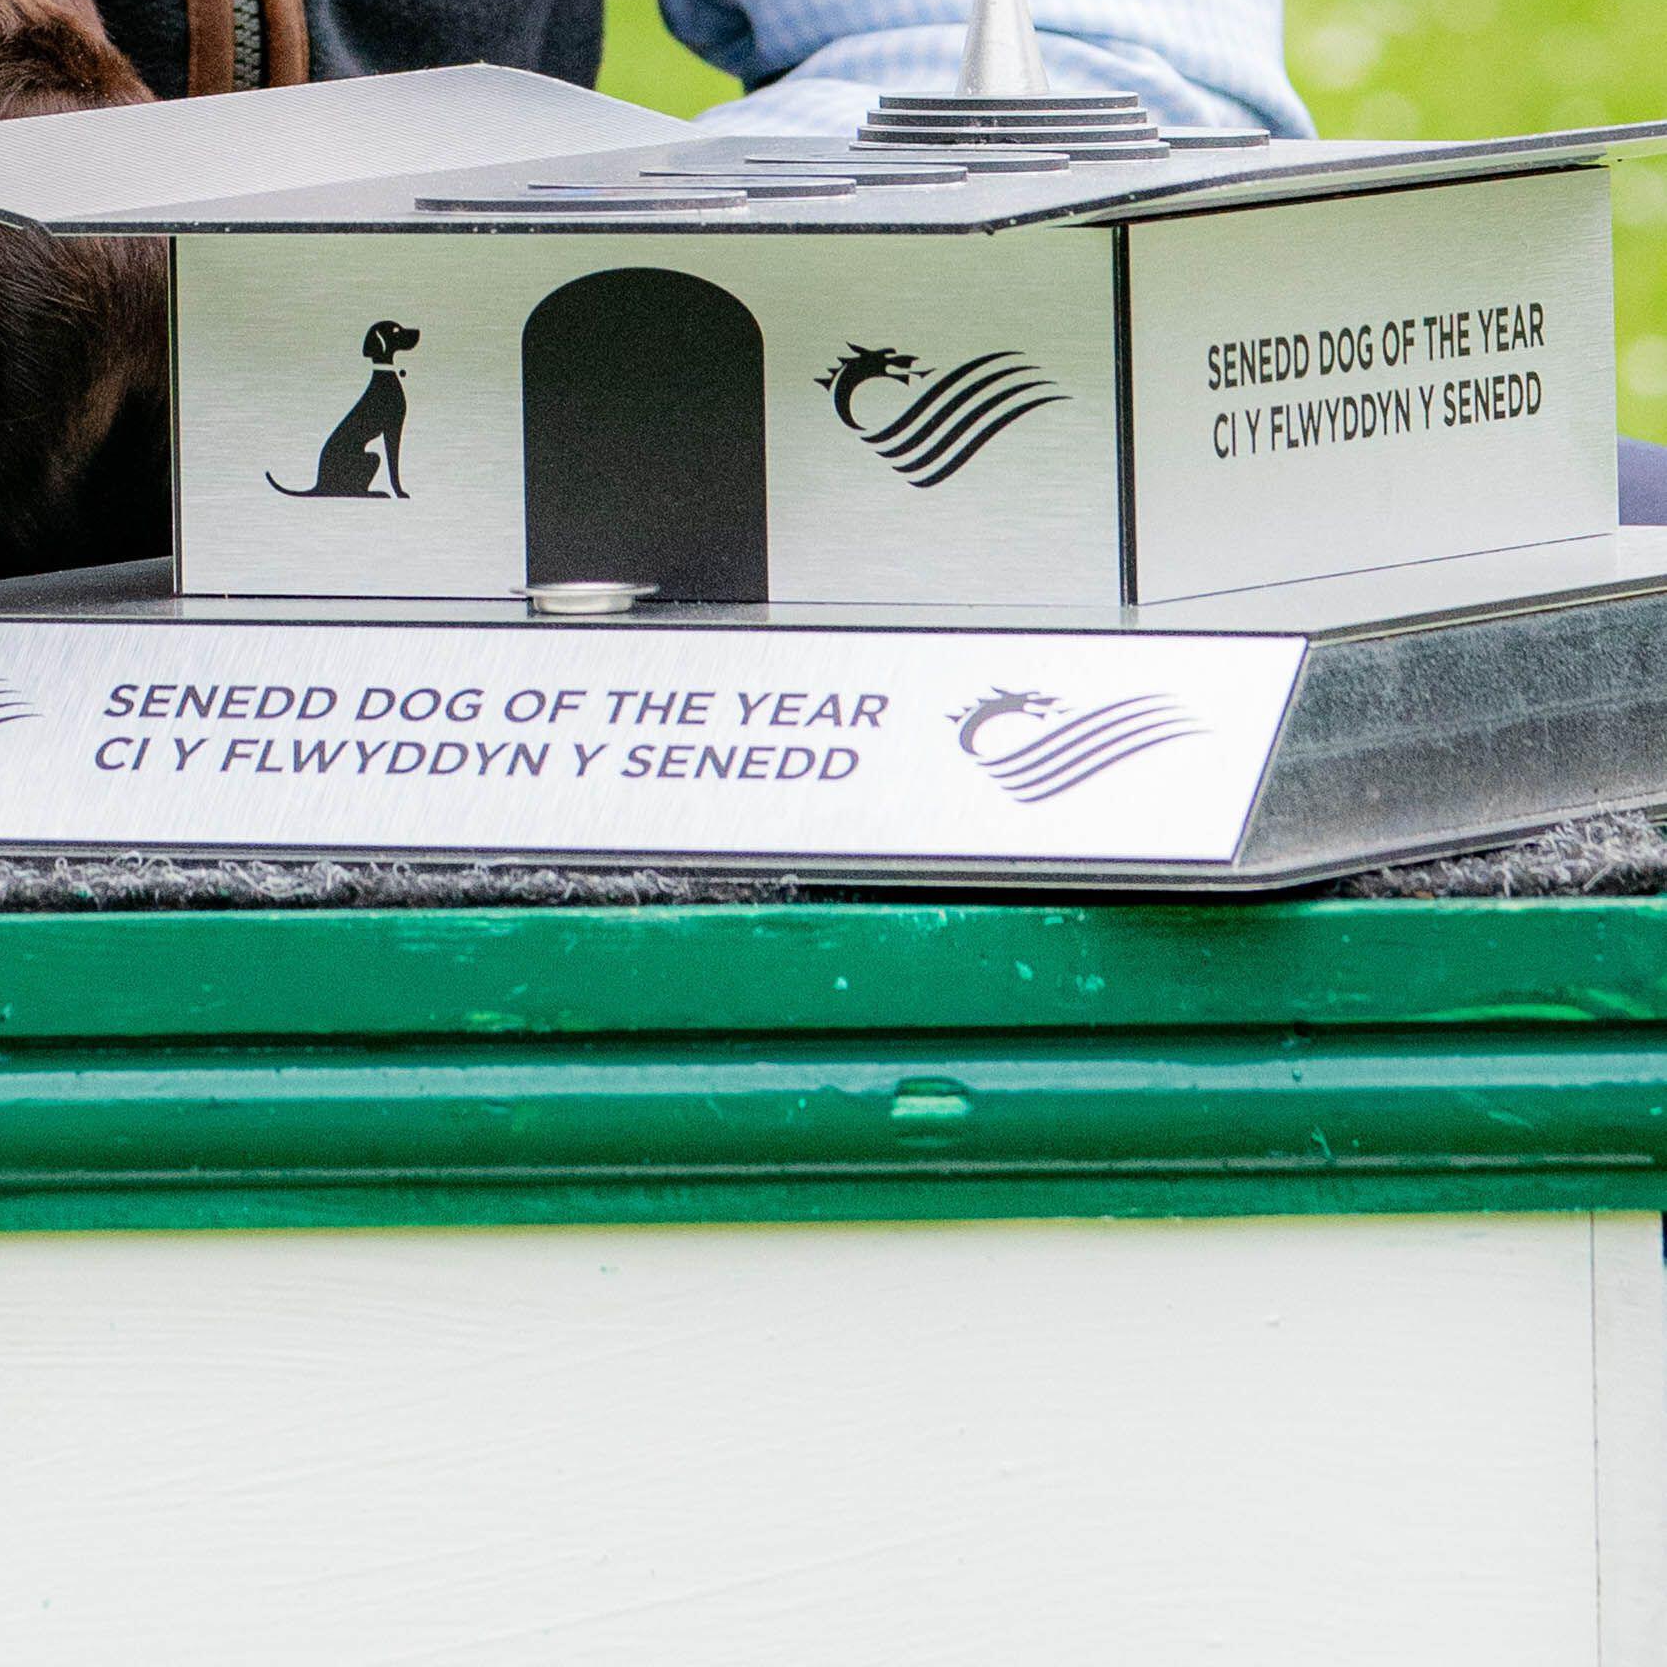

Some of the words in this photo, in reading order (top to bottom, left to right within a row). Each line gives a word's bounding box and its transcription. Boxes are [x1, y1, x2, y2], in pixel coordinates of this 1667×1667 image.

[1208, 334, 1310, 391] SENEDD
[1319, 324, 1373, 376] DOG
[1383, 318, 1415, 367] OF
[1423, 311, 1470, 361] THE
[1477, 302, 1544, 354] YEAR
[1213, 409, 1236, 459] CI
[1245, 408, 1261, 454] Y
[1271, 387, 1411, 451] FLWYDDYN
[1418, 384, 1435, 430] Y
[1443, 371, 1542, 427] SENEDD
[103, 684, 337, 720] SENEDD
[355, 687, 485, 722] DOG
[504, 689, 587, 723] OF
[607, 690, 715, 725] THE
[737, 692, 889, 727] YEAR
[94, 737, 151, 771] CI
[174, 737, 209, 771] Y
[220, 738, 550, 776] FLWYDDYN
[573, 742, 607, 777] Y
[621, 744, 859, 780] SENEDD
